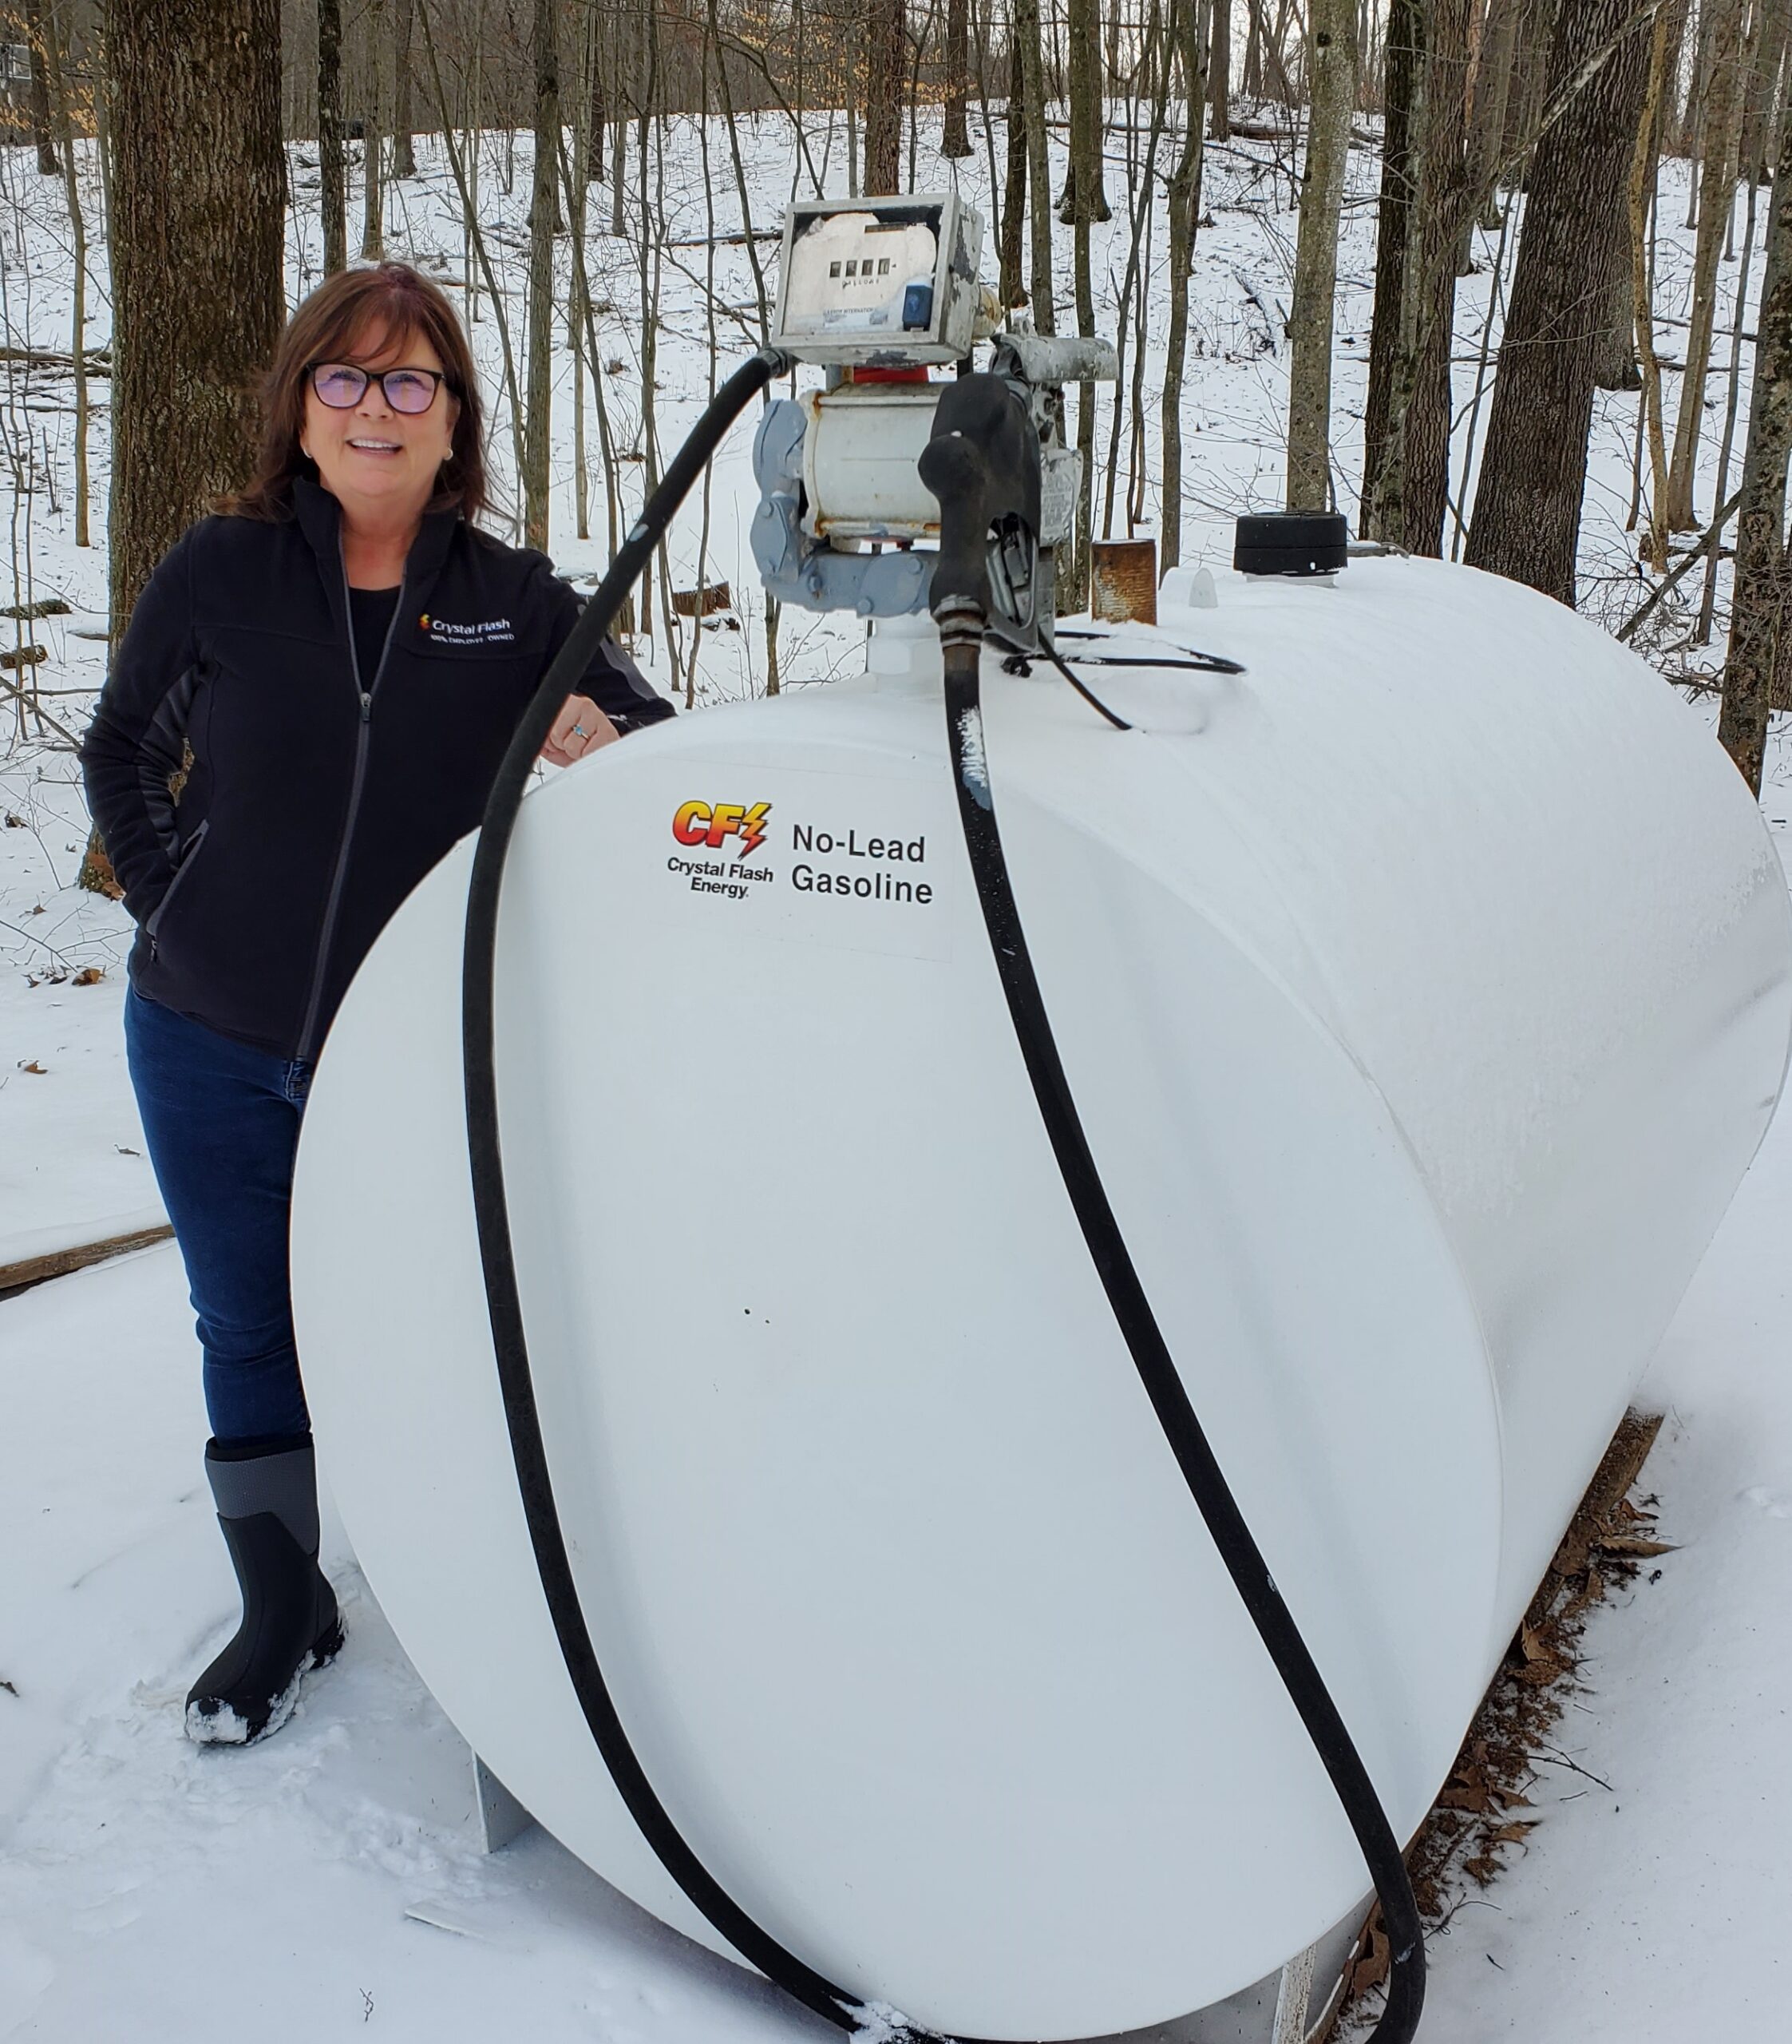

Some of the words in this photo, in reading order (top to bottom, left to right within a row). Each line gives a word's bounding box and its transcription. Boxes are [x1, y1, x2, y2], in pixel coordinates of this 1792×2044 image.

[432, 620, 476, 635] Crystal
[477, 618, 511, 633] Flash
[487, 633, 515, 642] OWNED
[793, 824, 925, 863] No-Lead
[667, 857, 724, 877] Crystal
[729, 864, 773, 882] Flash
[690, 877, 747, 900] Energy
[792, 864, 933, 904] Gasoline
